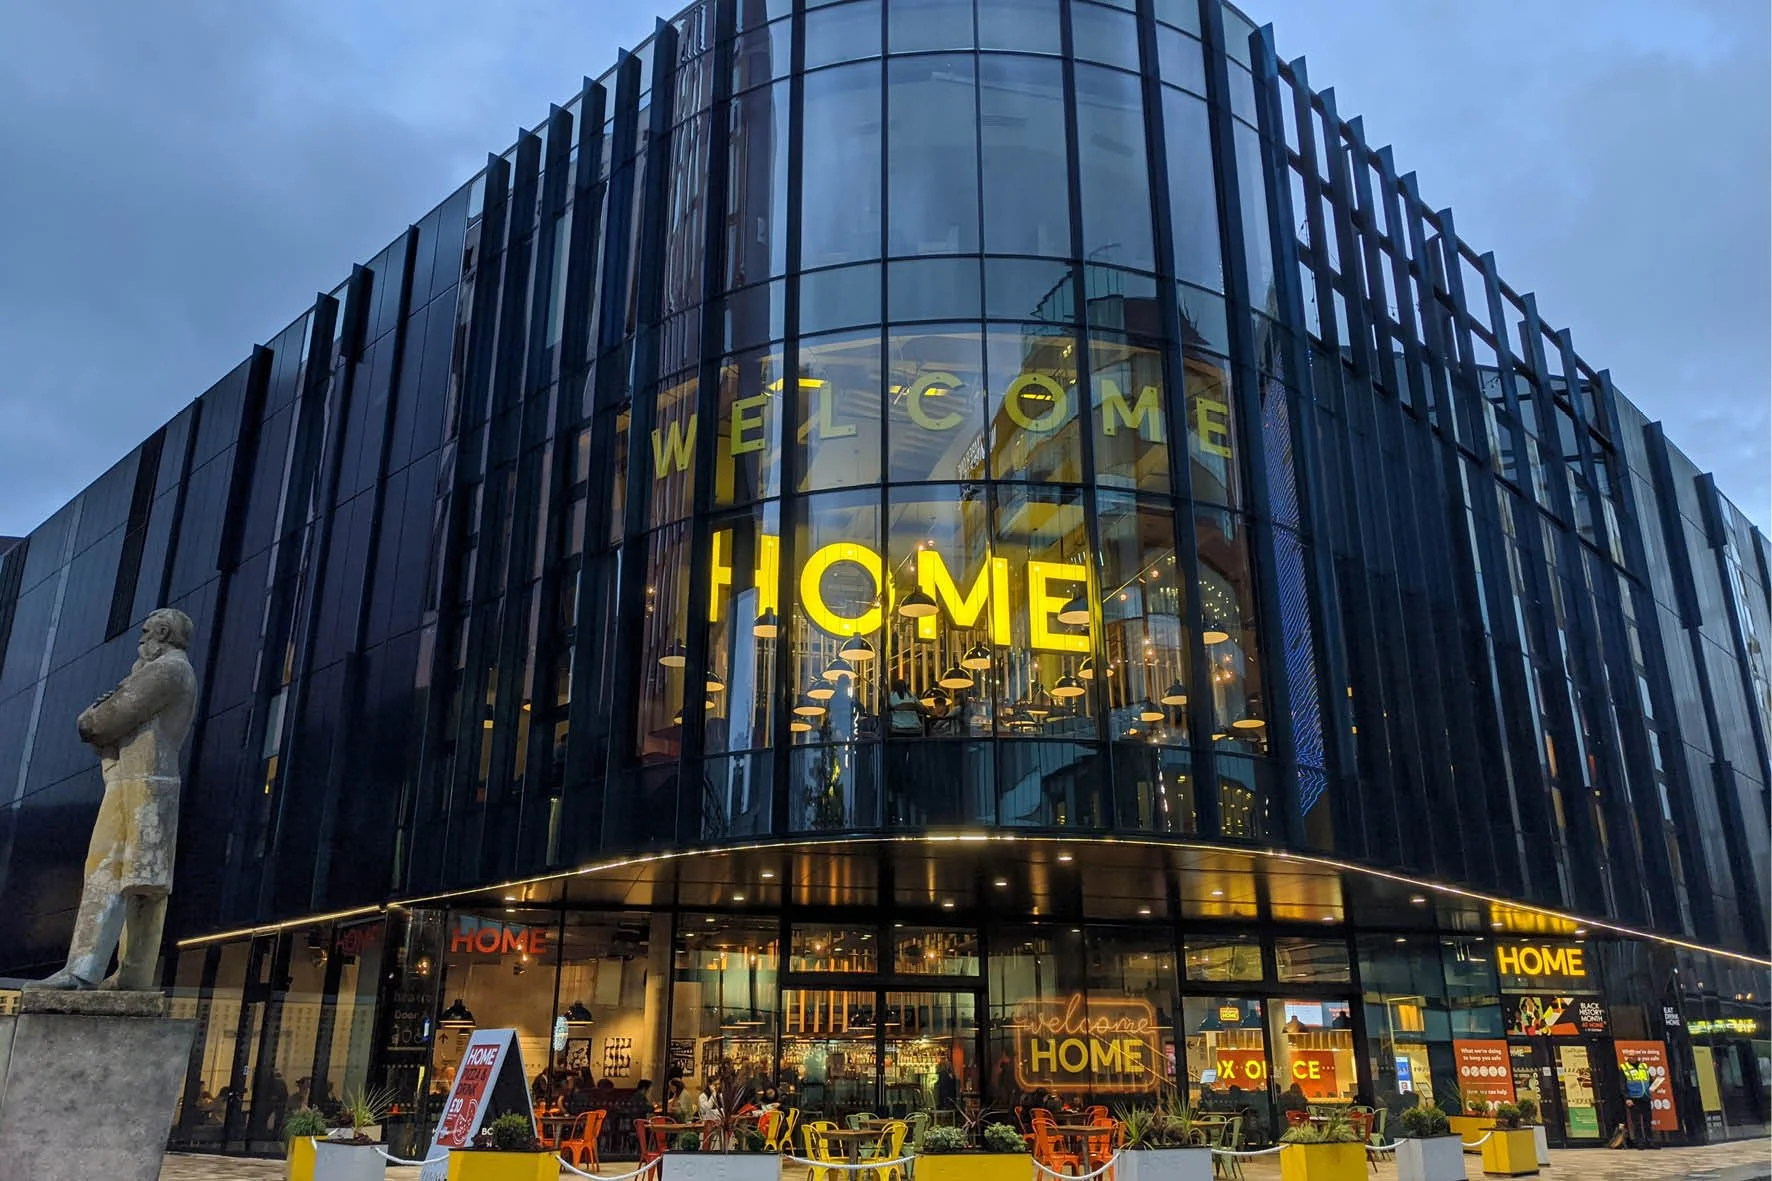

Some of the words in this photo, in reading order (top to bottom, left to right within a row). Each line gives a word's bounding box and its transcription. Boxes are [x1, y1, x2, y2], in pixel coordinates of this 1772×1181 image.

[652, 372, 1233, 479] WELCOME
[711, 531, 1090, 652] HOME
[450, 927, 547, 953] HOME
[1497, 946, 1586, 976] HOME
[1013, 992, 1153, 1034] welcome
[467, 1048, 498, 1065] HOME
[1031, 1038, 1146, 1073] HOME
